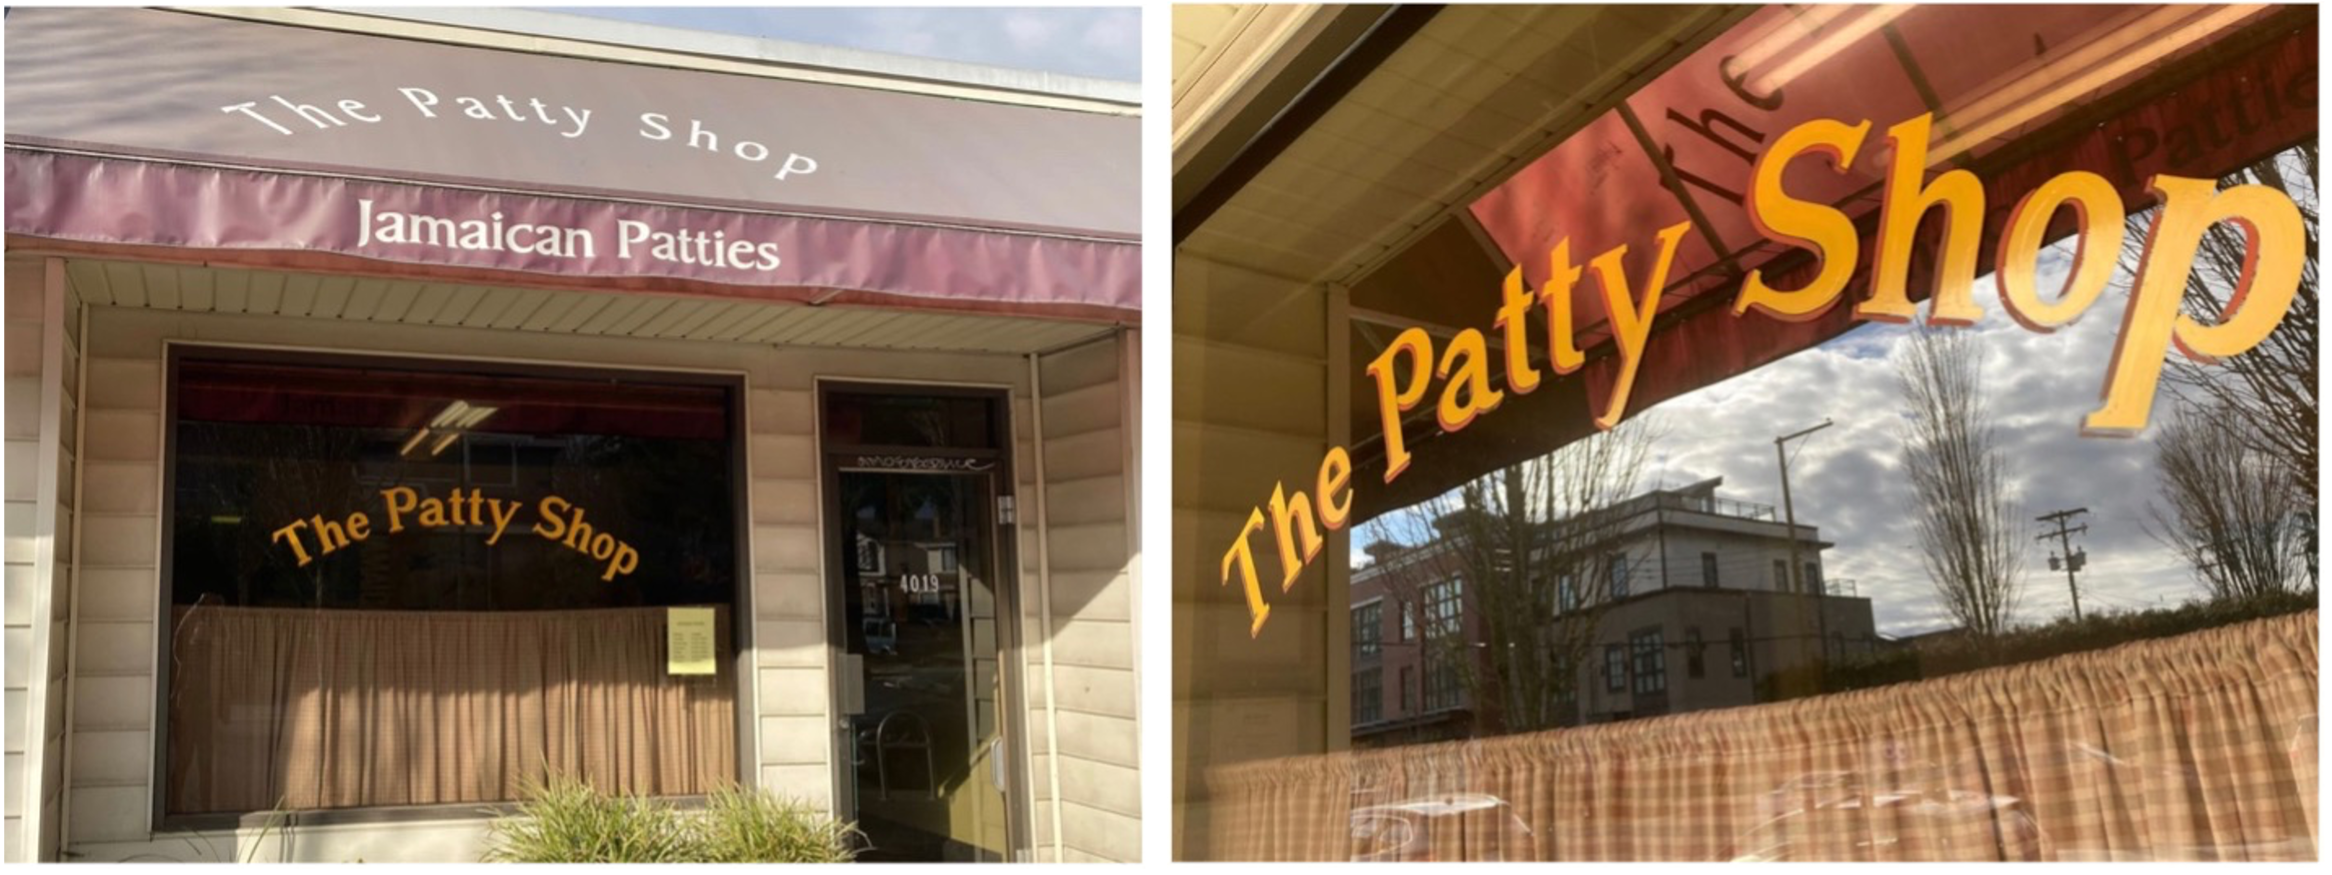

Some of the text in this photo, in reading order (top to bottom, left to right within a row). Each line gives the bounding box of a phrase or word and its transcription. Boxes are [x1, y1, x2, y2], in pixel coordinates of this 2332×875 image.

[222, 87, 818, 180] The Patty Shop
[357, 199, 781, 271] Jamaican Patties
[1221, 111, 2306, 639] The Patty Shop
[272, 486, 639, 583] The Patty Shop
[900, 573, 940, 593] 4019
